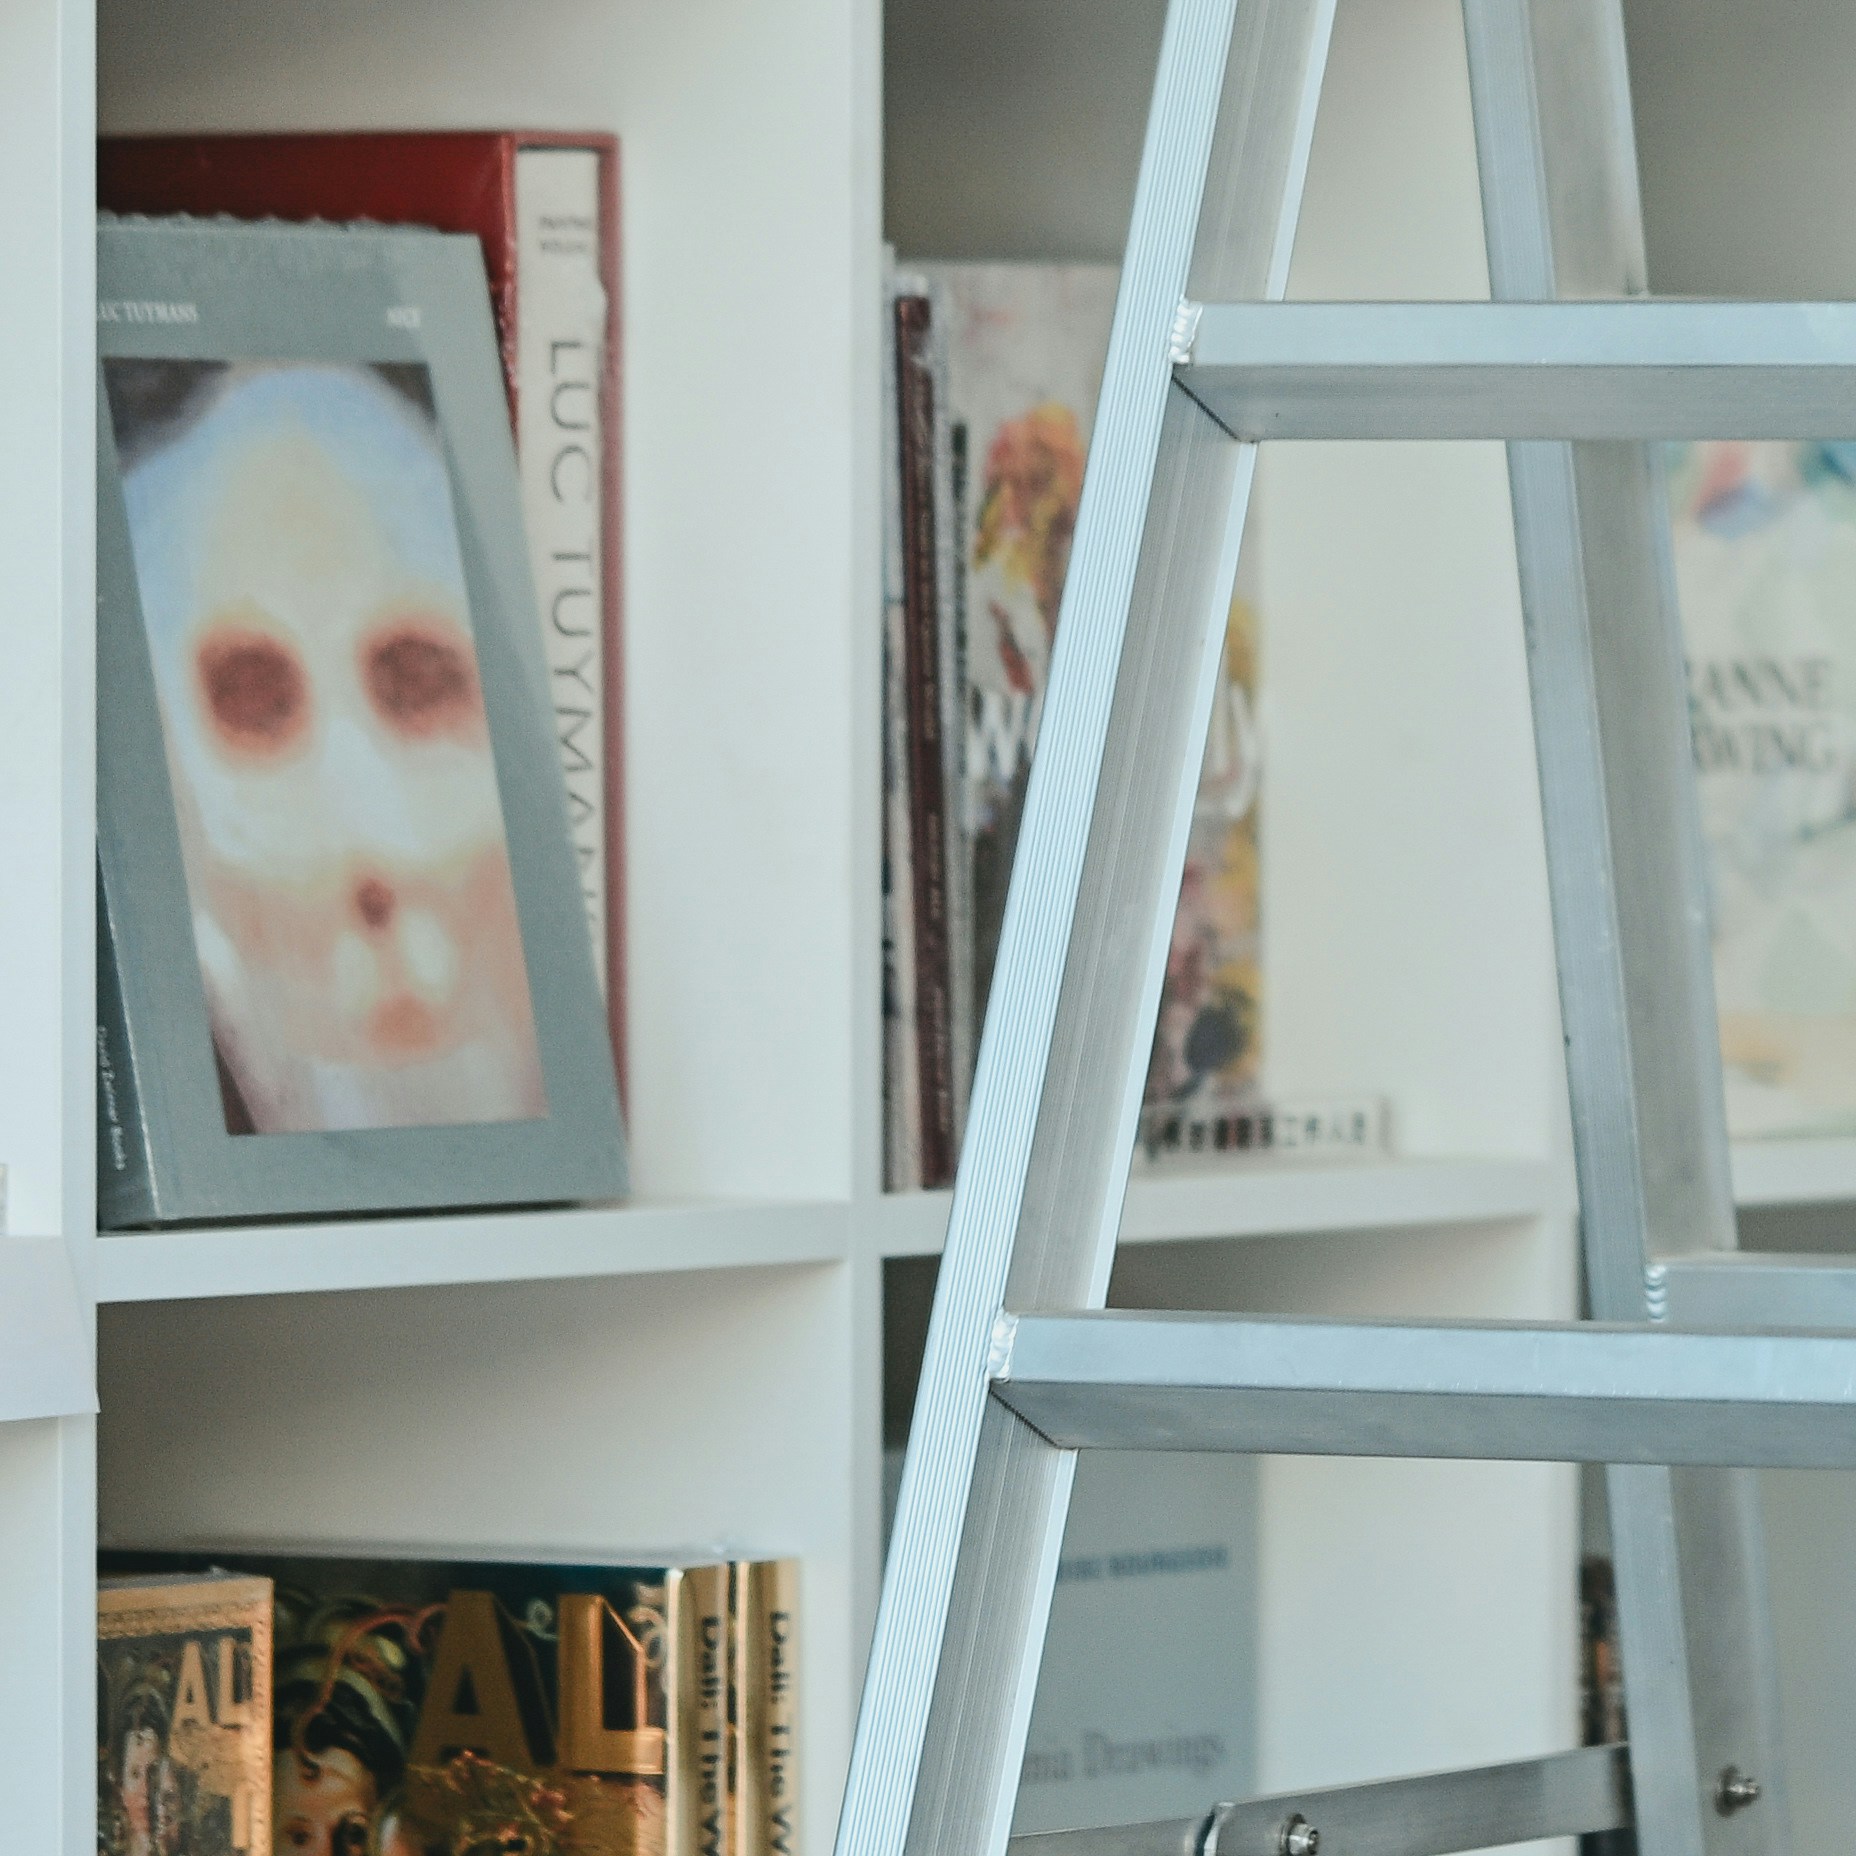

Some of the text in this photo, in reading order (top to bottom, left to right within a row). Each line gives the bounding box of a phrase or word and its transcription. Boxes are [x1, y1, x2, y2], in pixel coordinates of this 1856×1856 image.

[548, 338, 598, 934] LUC TUYMA
[1683, 654, 1836, 712] ANNE
[1085, 1729, 1225, 1777] Drawings
